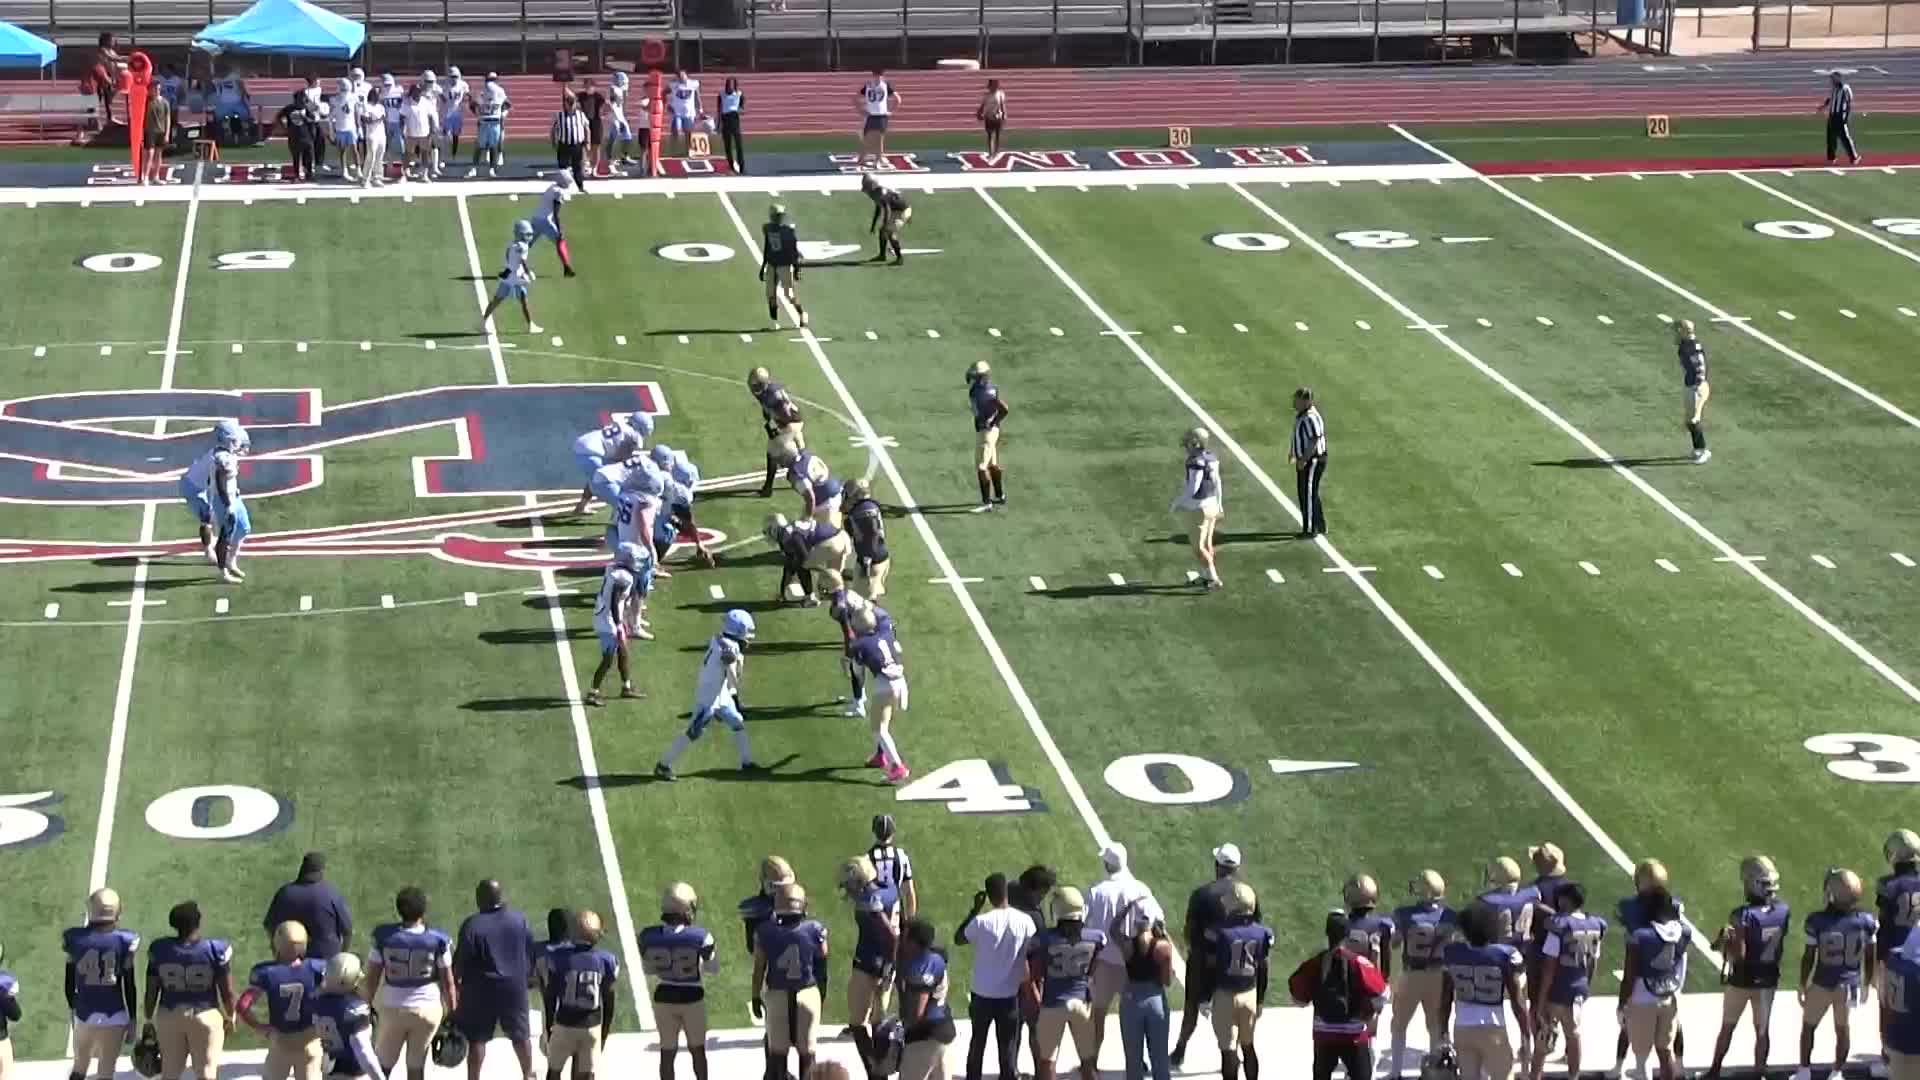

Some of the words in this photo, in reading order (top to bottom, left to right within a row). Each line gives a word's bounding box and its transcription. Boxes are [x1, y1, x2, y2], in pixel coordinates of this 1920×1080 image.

[1172, 129, 1189, 145] 30
[1649, 117, 1667, 134] 20
[690, 137, 708, 153] 40
[895, 754, 1236, 814] 40
[71, 948, 118, 986] 41
[776, 944, 801, 980] 4
[278, 981, 305, 1023] 7
[564, 969, 602, 1010] 13
